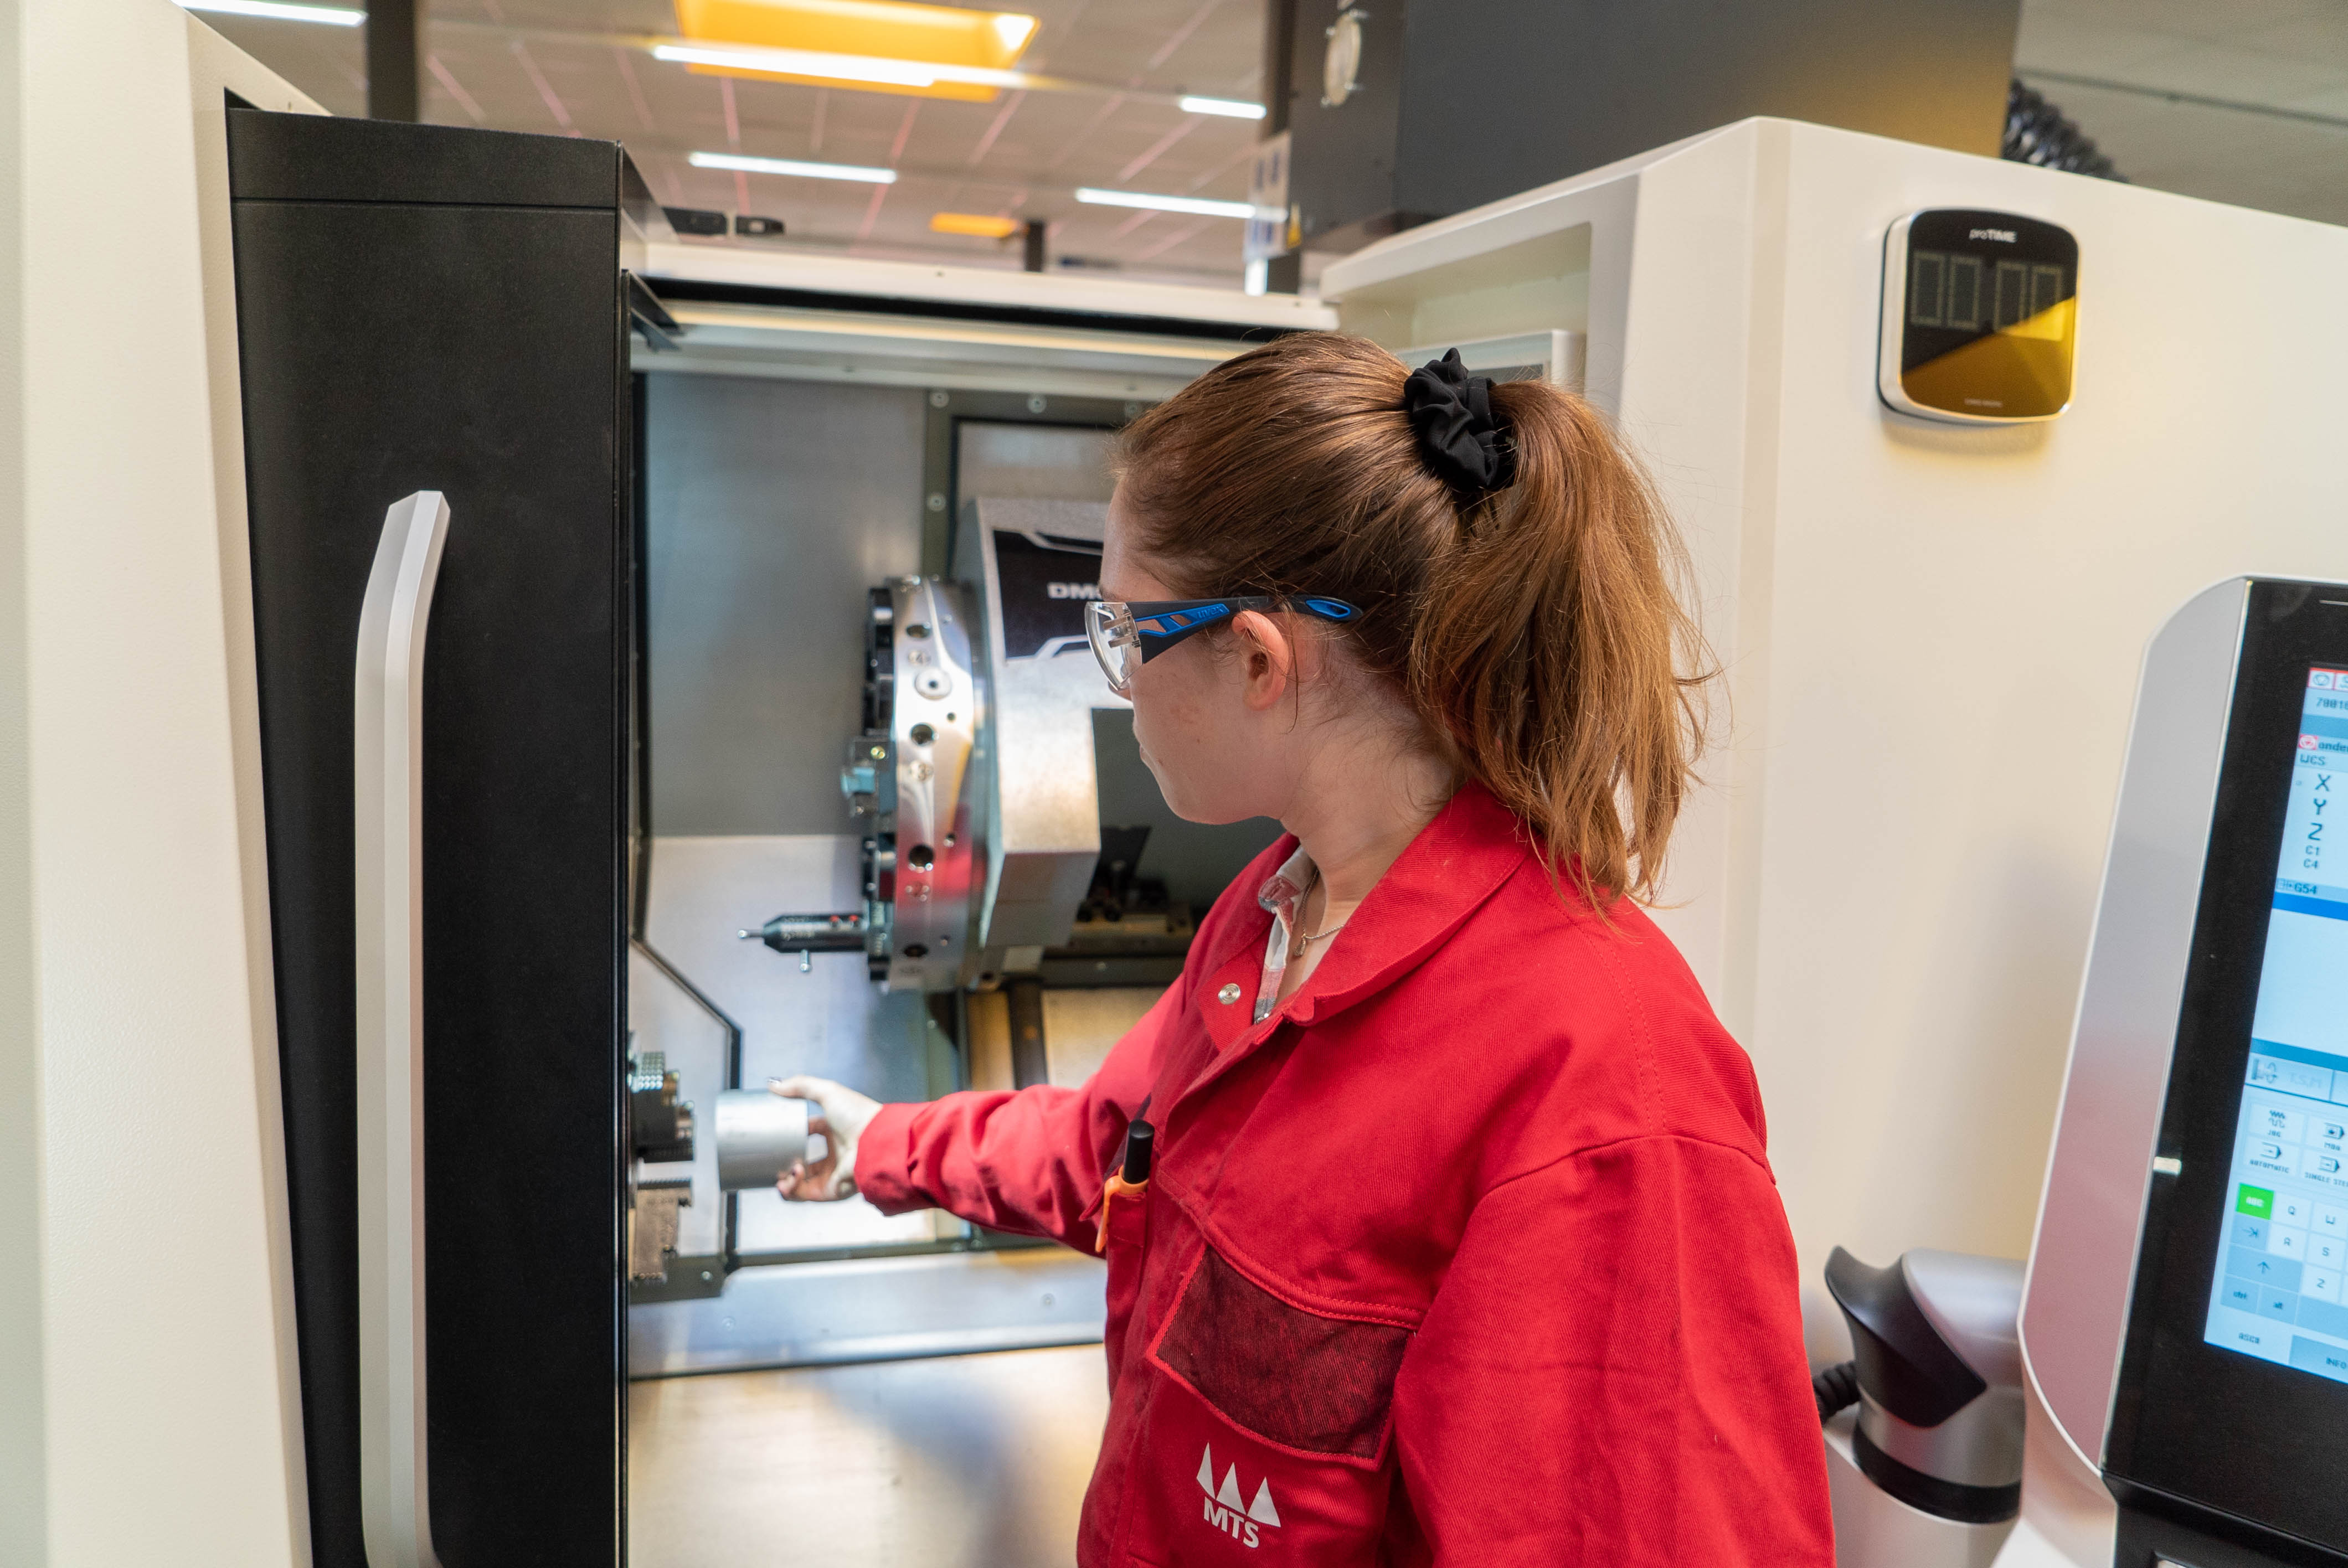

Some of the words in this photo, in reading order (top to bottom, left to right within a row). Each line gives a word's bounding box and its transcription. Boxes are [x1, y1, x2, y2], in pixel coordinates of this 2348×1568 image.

[1197, 606, 1223, 618] uvex
[2318, 742, 2348, 752] onde
[2300, 754, 2326, 766] WCS
[2315, 773, 2331, 792] X
[2313, 798, 2326, 815] Y
[2308, 823, 2323, 840] Z
[2305, 845, 2320, 855] C1
[2304, 859, 2319, 869] C4
[2295, 883, 2317, 894] G54
[2305, 1172, 2330, 1183] SINGLE
[2288, 1205, 2295, 1215] Q
[2325, 1215, 2335, 1225] W
[2322, 1247, 2330, 1256] S
[2326, 1357, 2347, 1369] INFO
[1203, 1496, 1259, 1549] MTS
